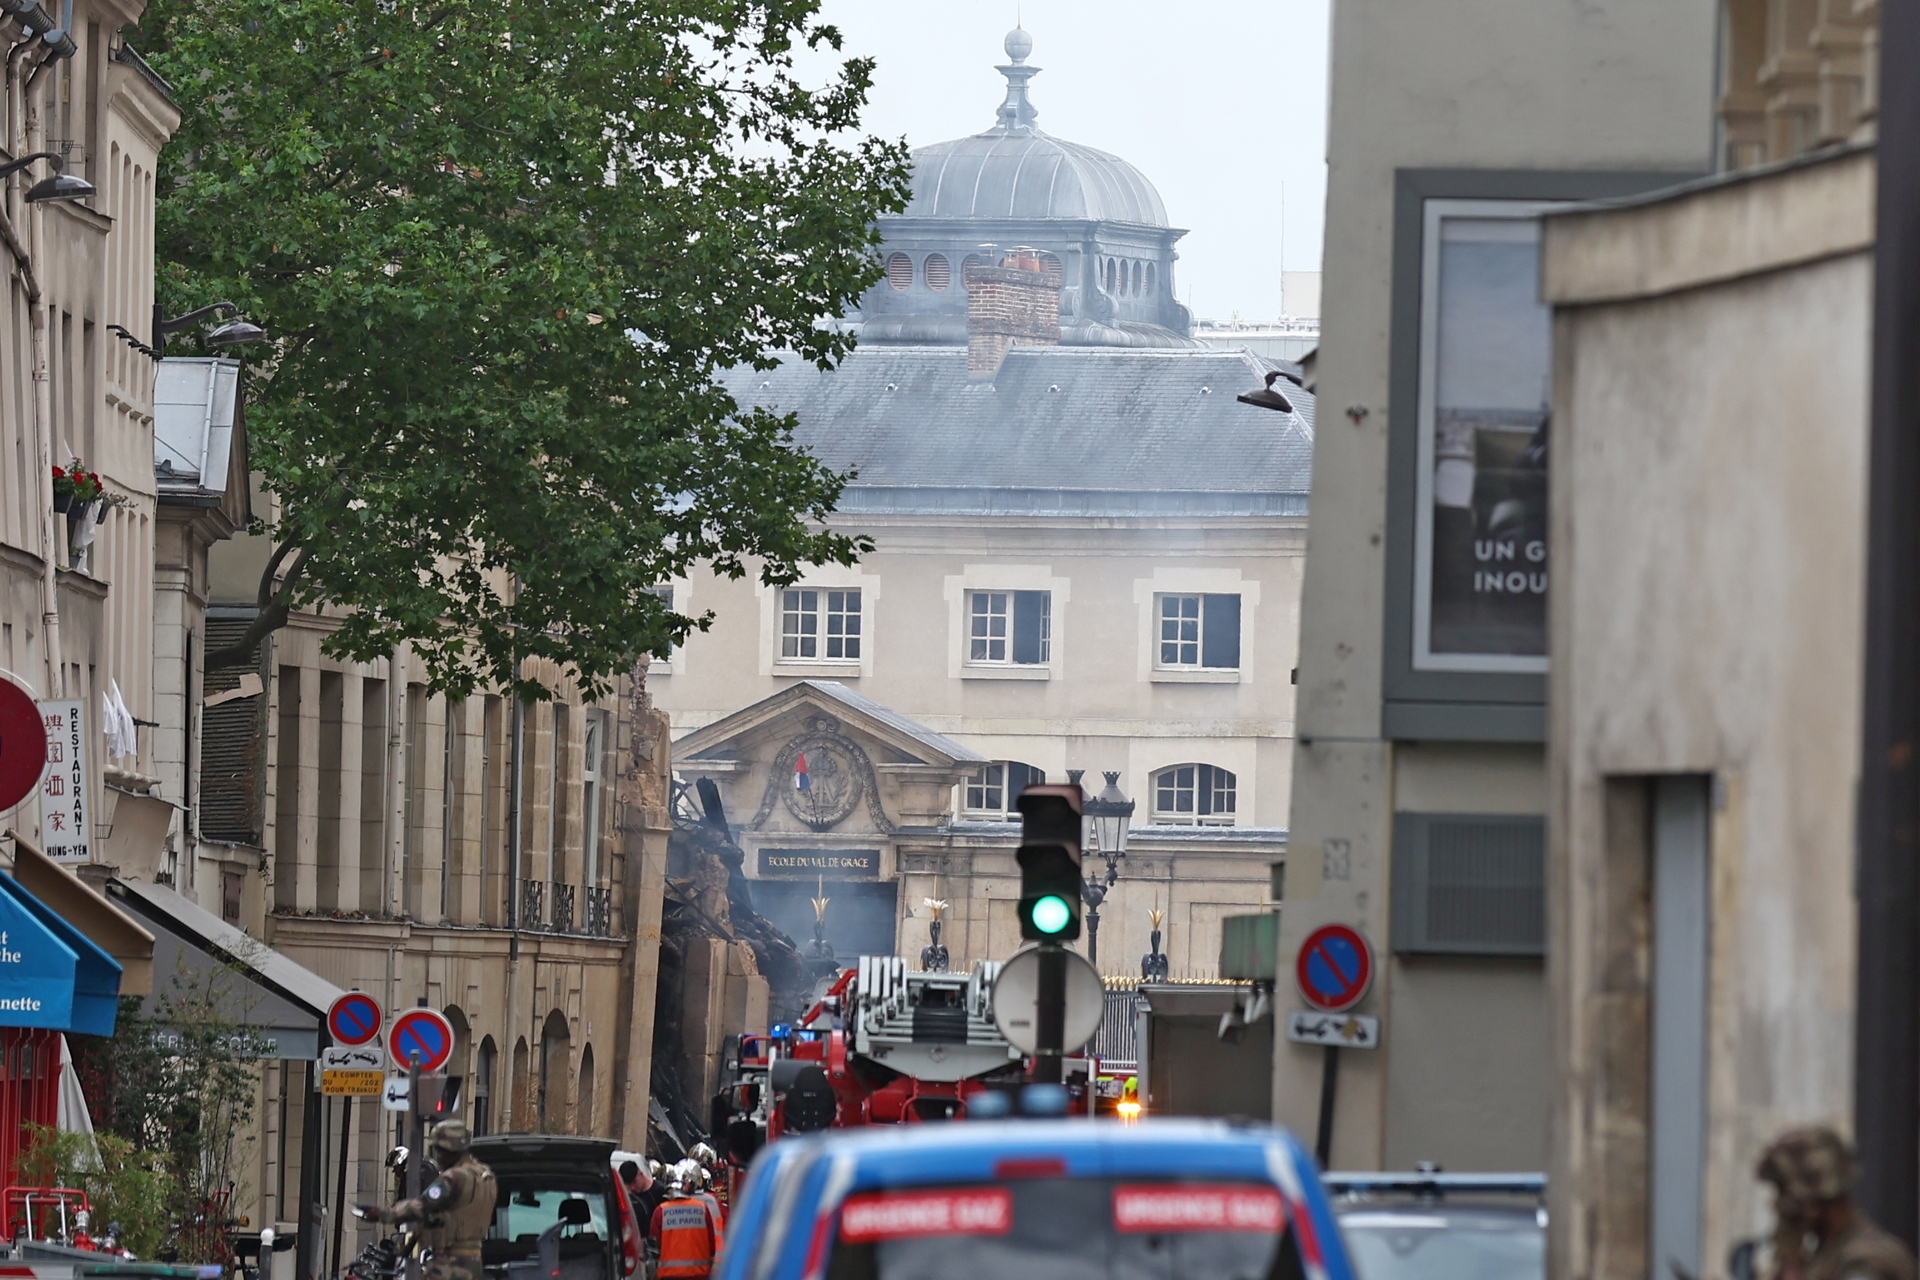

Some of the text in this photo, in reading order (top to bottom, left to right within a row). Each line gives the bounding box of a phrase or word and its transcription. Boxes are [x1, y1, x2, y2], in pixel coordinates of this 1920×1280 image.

[1475, 540, 1515, 562] UN
[1474, 571, 1548, 594] INOU
[71, 708, 82, 836] RESTAURANT
[797, 857, 810, 866] DU
[812, 857, 826, 868] VAL
[828, 857, 838, 868] DE
[664, 1208, 704, 1216] POMPIERS
[679, 1217, 702, 1225] PARIS
